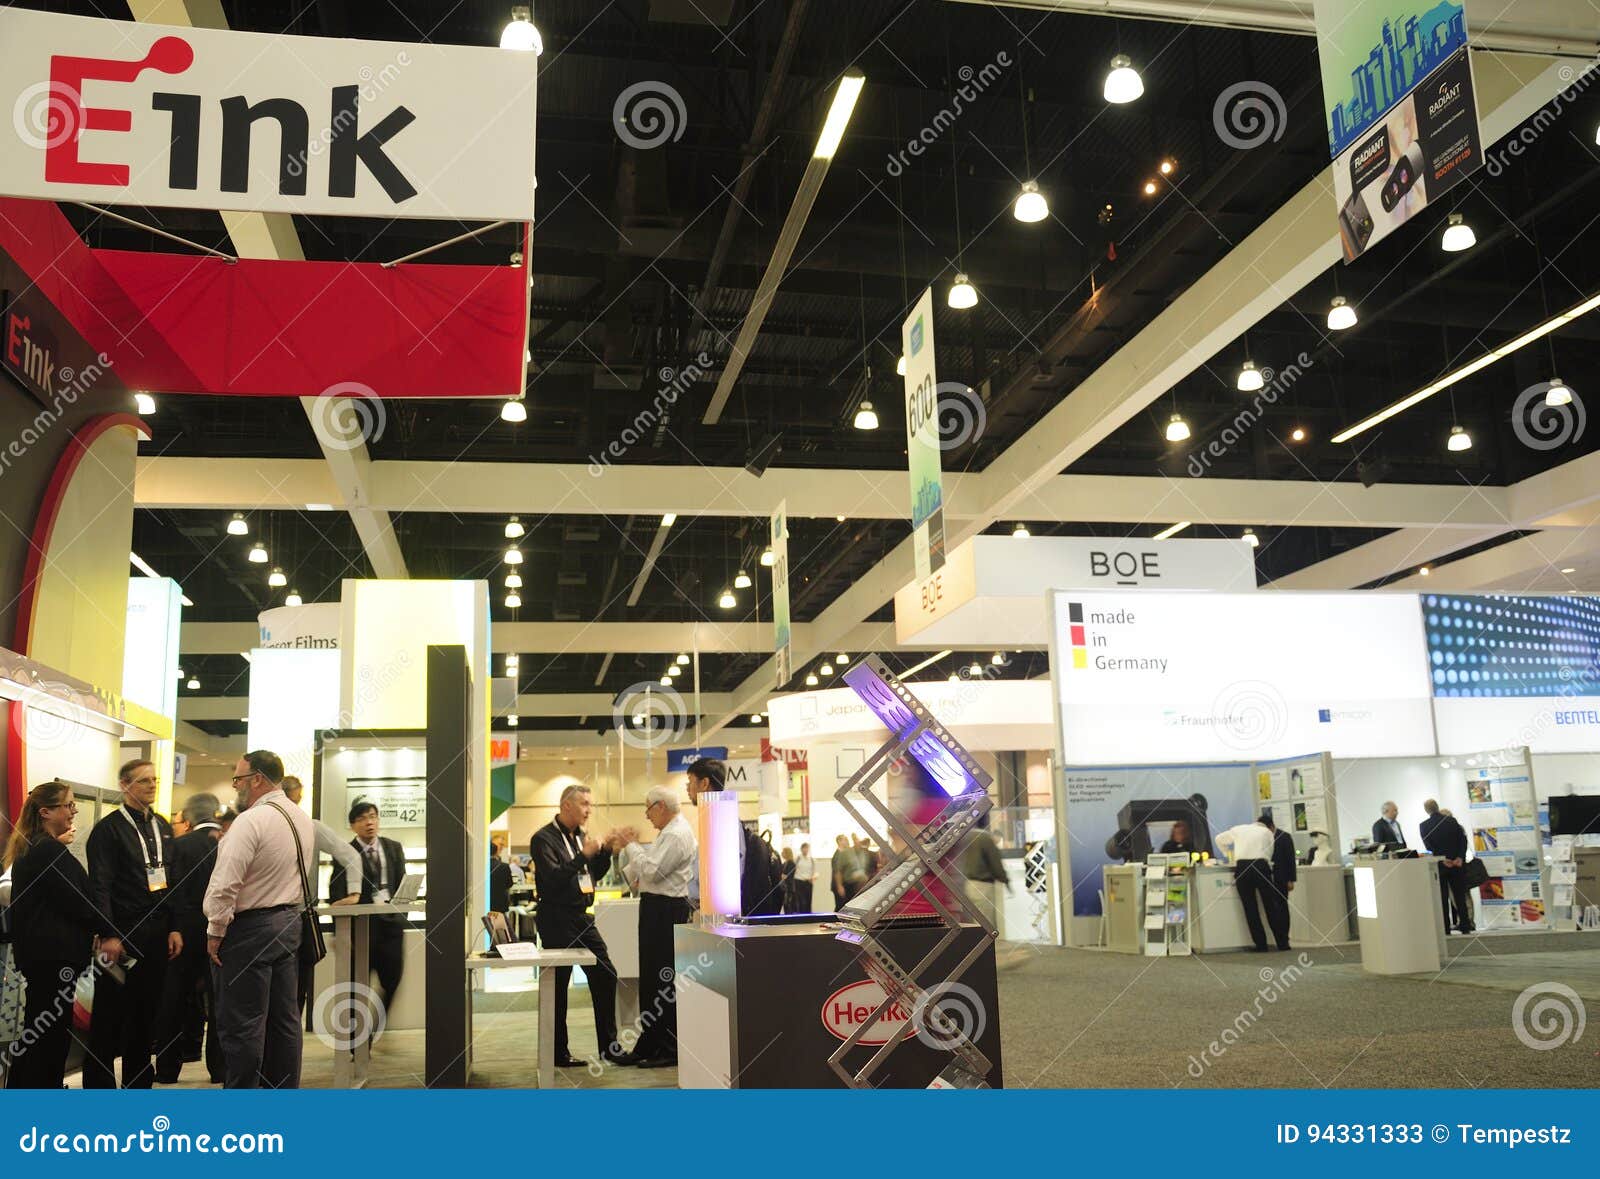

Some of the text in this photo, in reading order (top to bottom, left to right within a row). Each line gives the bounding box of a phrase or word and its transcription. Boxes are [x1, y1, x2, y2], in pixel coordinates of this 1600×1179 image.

[1429, 82, 1461, 116] RADIANT
[1354, 135, 1385, 169] RADIANT
[909, 373, 933, 438] 600
[1090, 551, 1161, 585] BOE
[921, 575, 943, 613] BOE
[1091, 609, 1135, 624] made
[295, 635, 338, 649] Films
[1092, 632, 1107, 647] in
[1095, 655, 1168, 674] Germany
[1180, 714, 1244, 727] Fraunhofer
[769, 746, 808, 764] SILV
